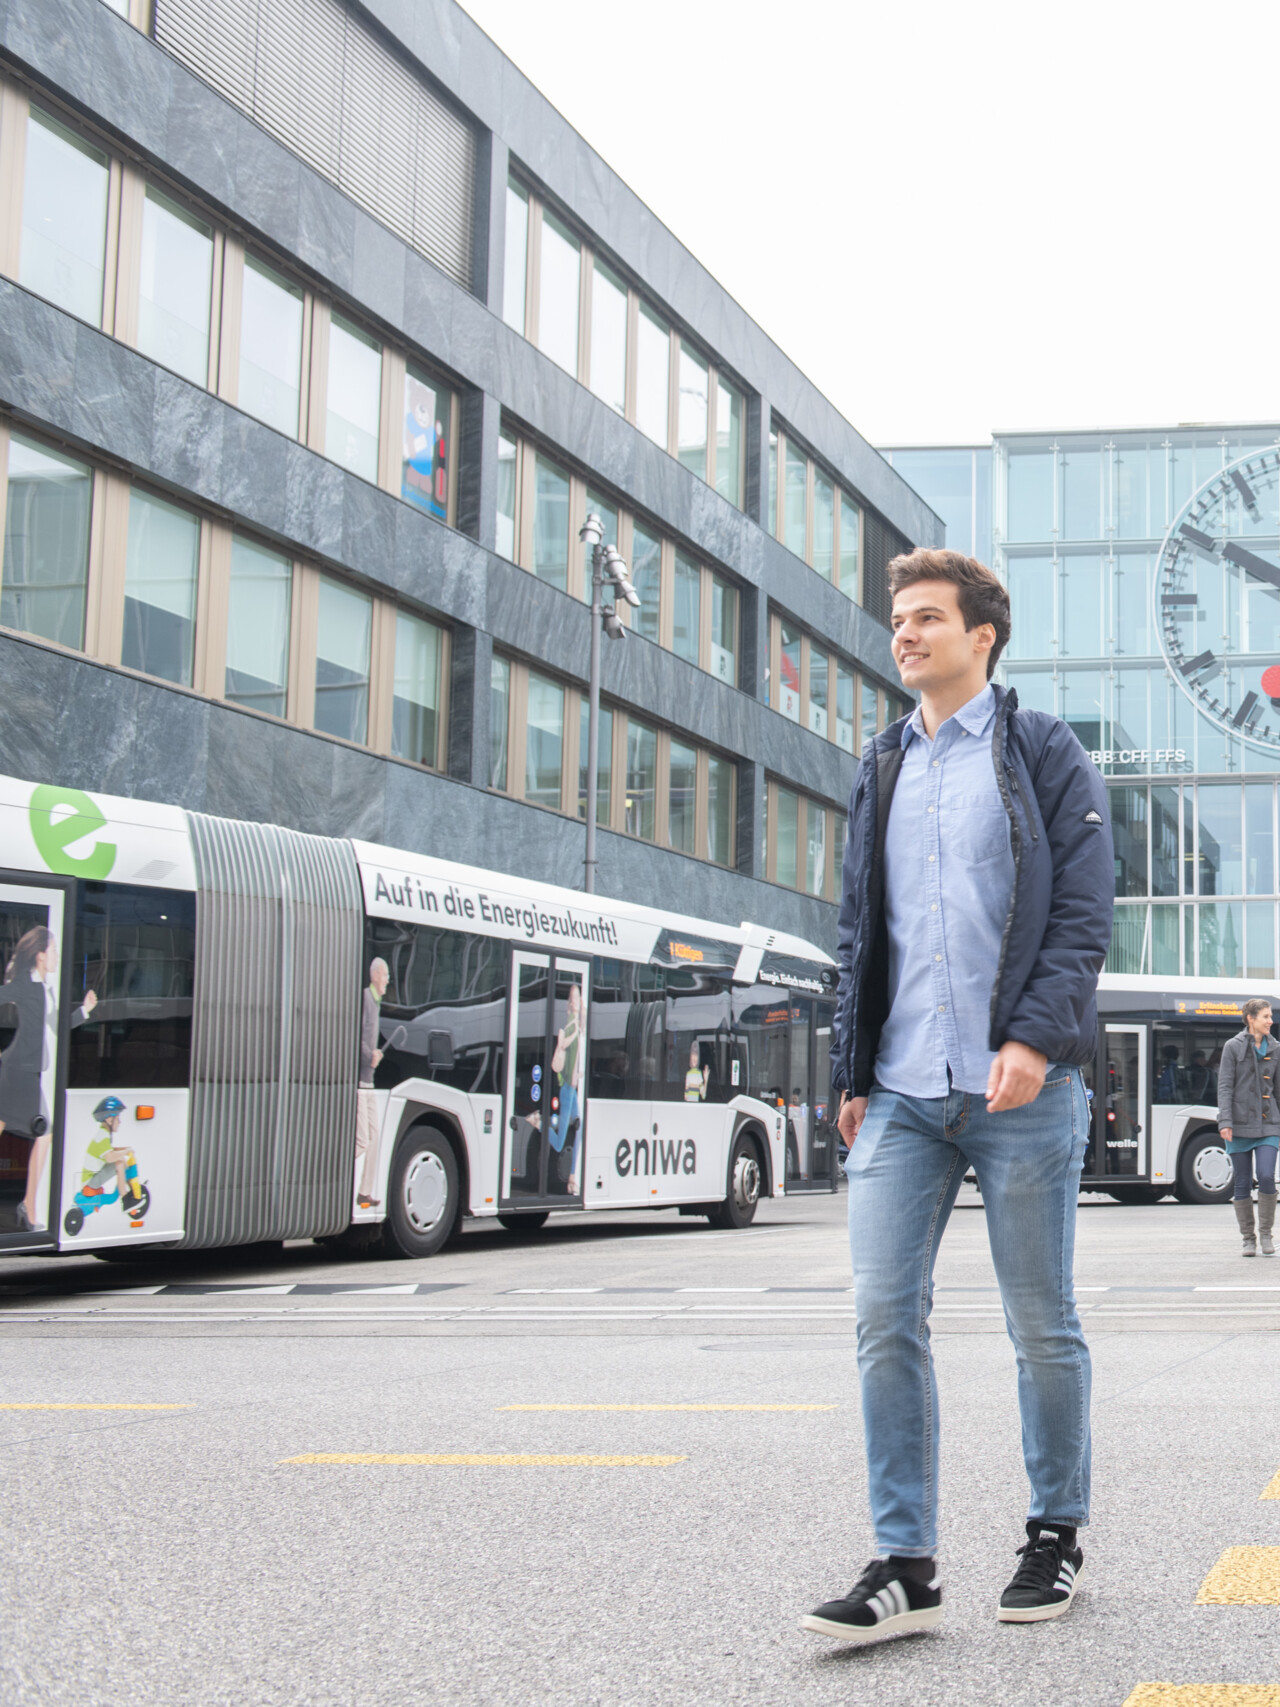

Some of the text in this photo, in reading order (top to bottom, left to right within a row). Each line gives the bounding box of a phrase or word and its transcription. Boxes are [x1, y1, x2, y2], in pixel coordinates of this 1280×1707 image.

[1085, 748, 1186, 764] BB CFF FFS
[375, 872, 619, 945] Auf in die Energiezukunft!
[1178, 1002, 1186, 1013] 2
[615, 1122, 696, 1177] eniwa
[1106, 1139, 1138, 1148] welle
